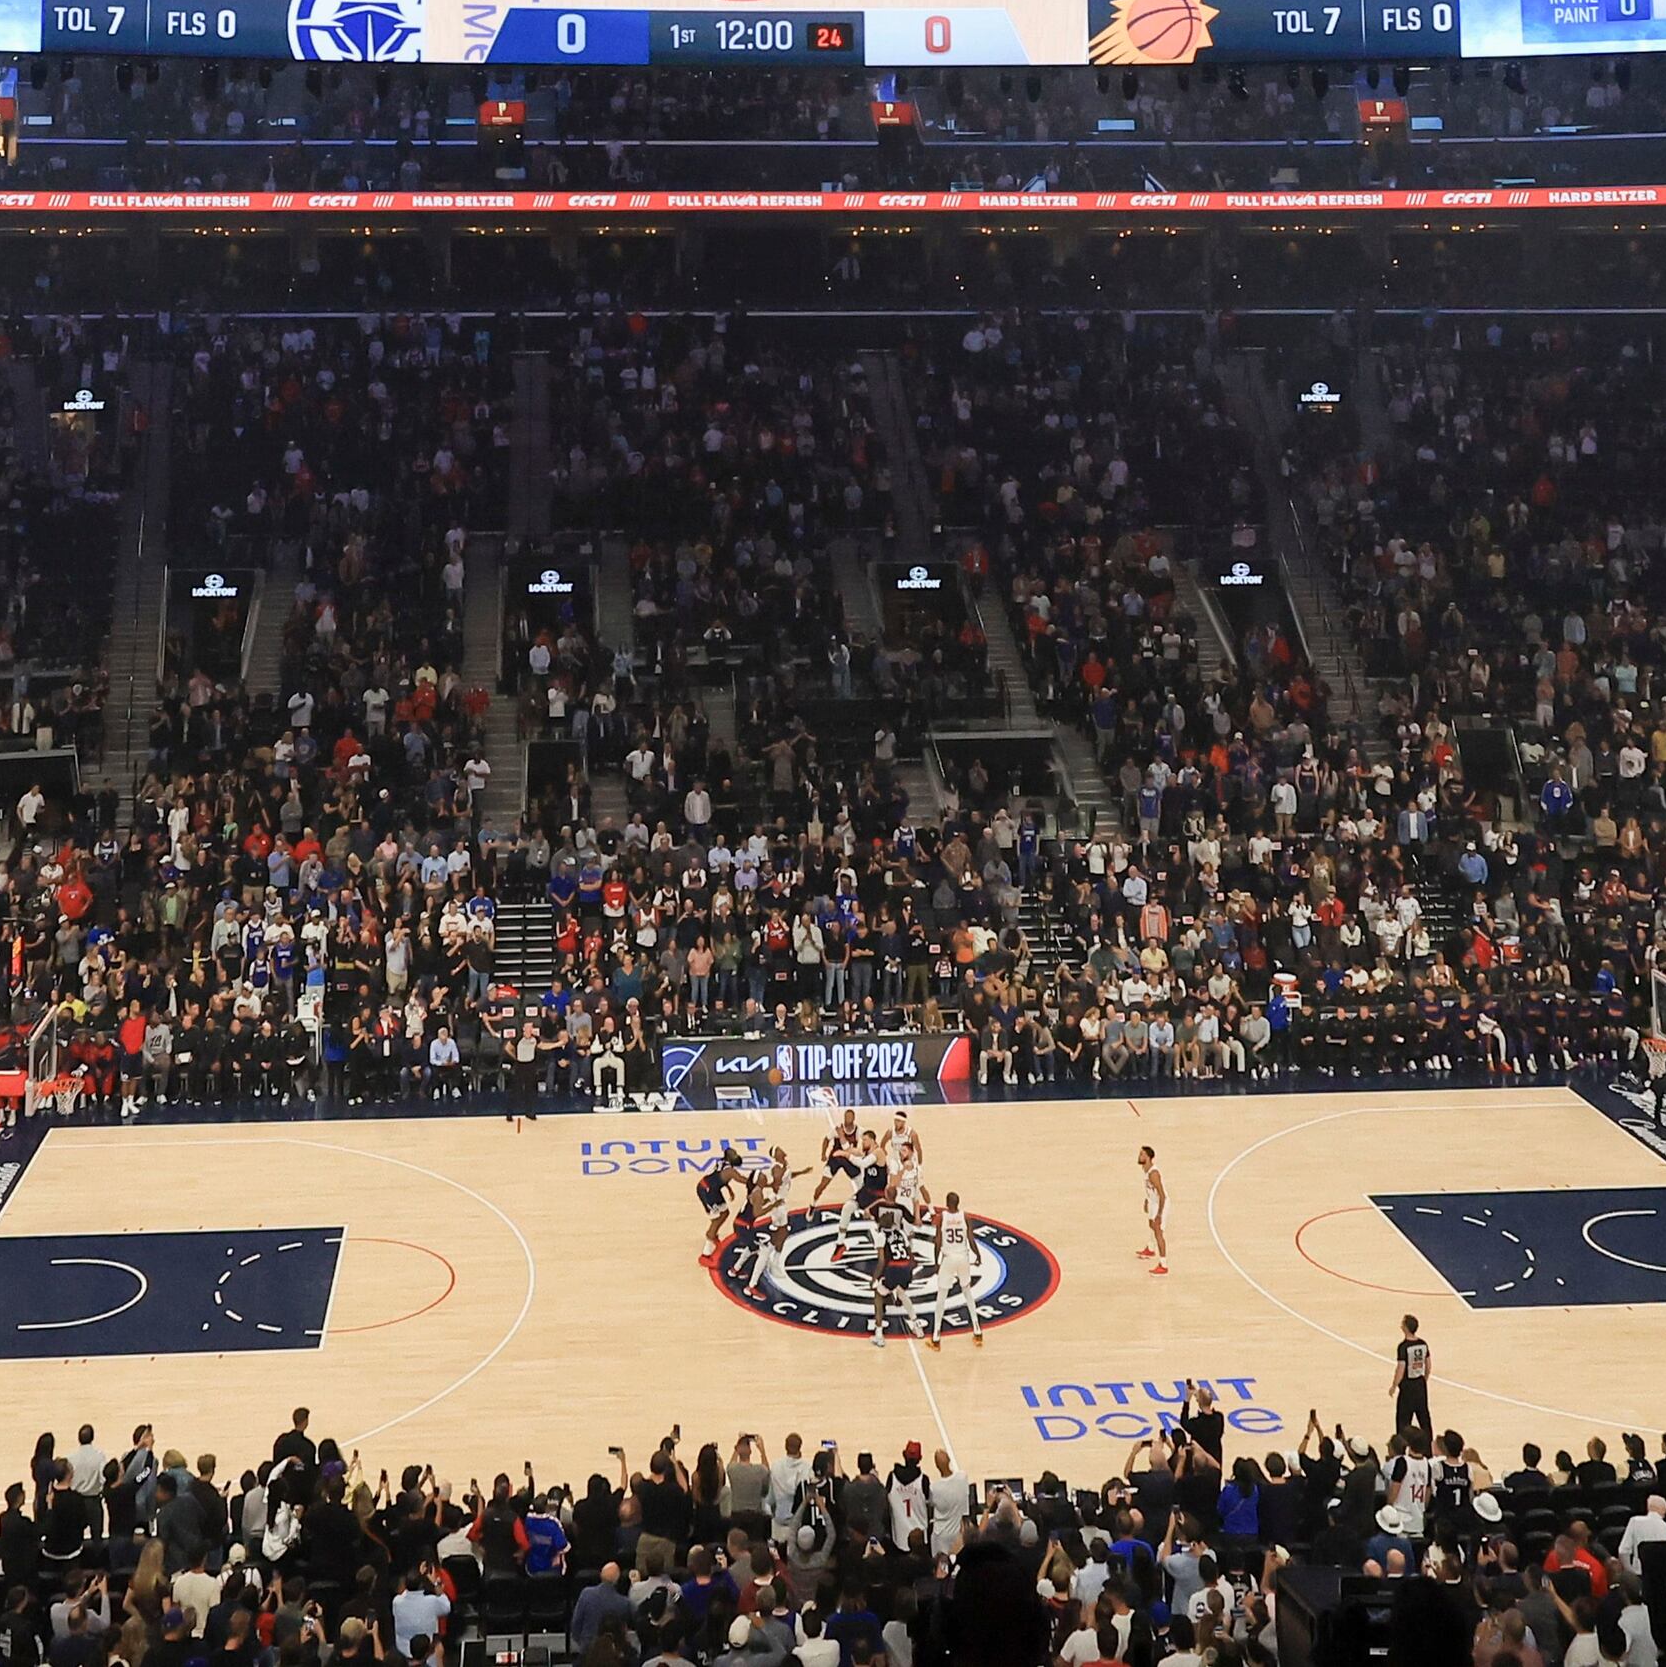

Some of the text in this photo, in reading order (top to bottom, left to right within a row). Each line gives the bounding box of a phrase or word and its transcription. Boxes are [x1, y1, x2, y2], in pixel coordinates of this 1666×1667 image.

[54, 7, 235, 38] TOL 7 FLS 0
[671, 21, 842, 49] 1ST 12:00 24
[1549, 189, 1657, 203] HARD SELTZER
[867, 1043, 917, 1078] 2024
[901, 1187, 911, 1197] 20
[946, 1229, 964, 1243] 35
[891, 1244, 908, 1259] 55
[1409, 1484, 1424, 1503] 14
[1453, 1488, 1461, 1506] 1
[903, 1498, 911, 1517] 1
